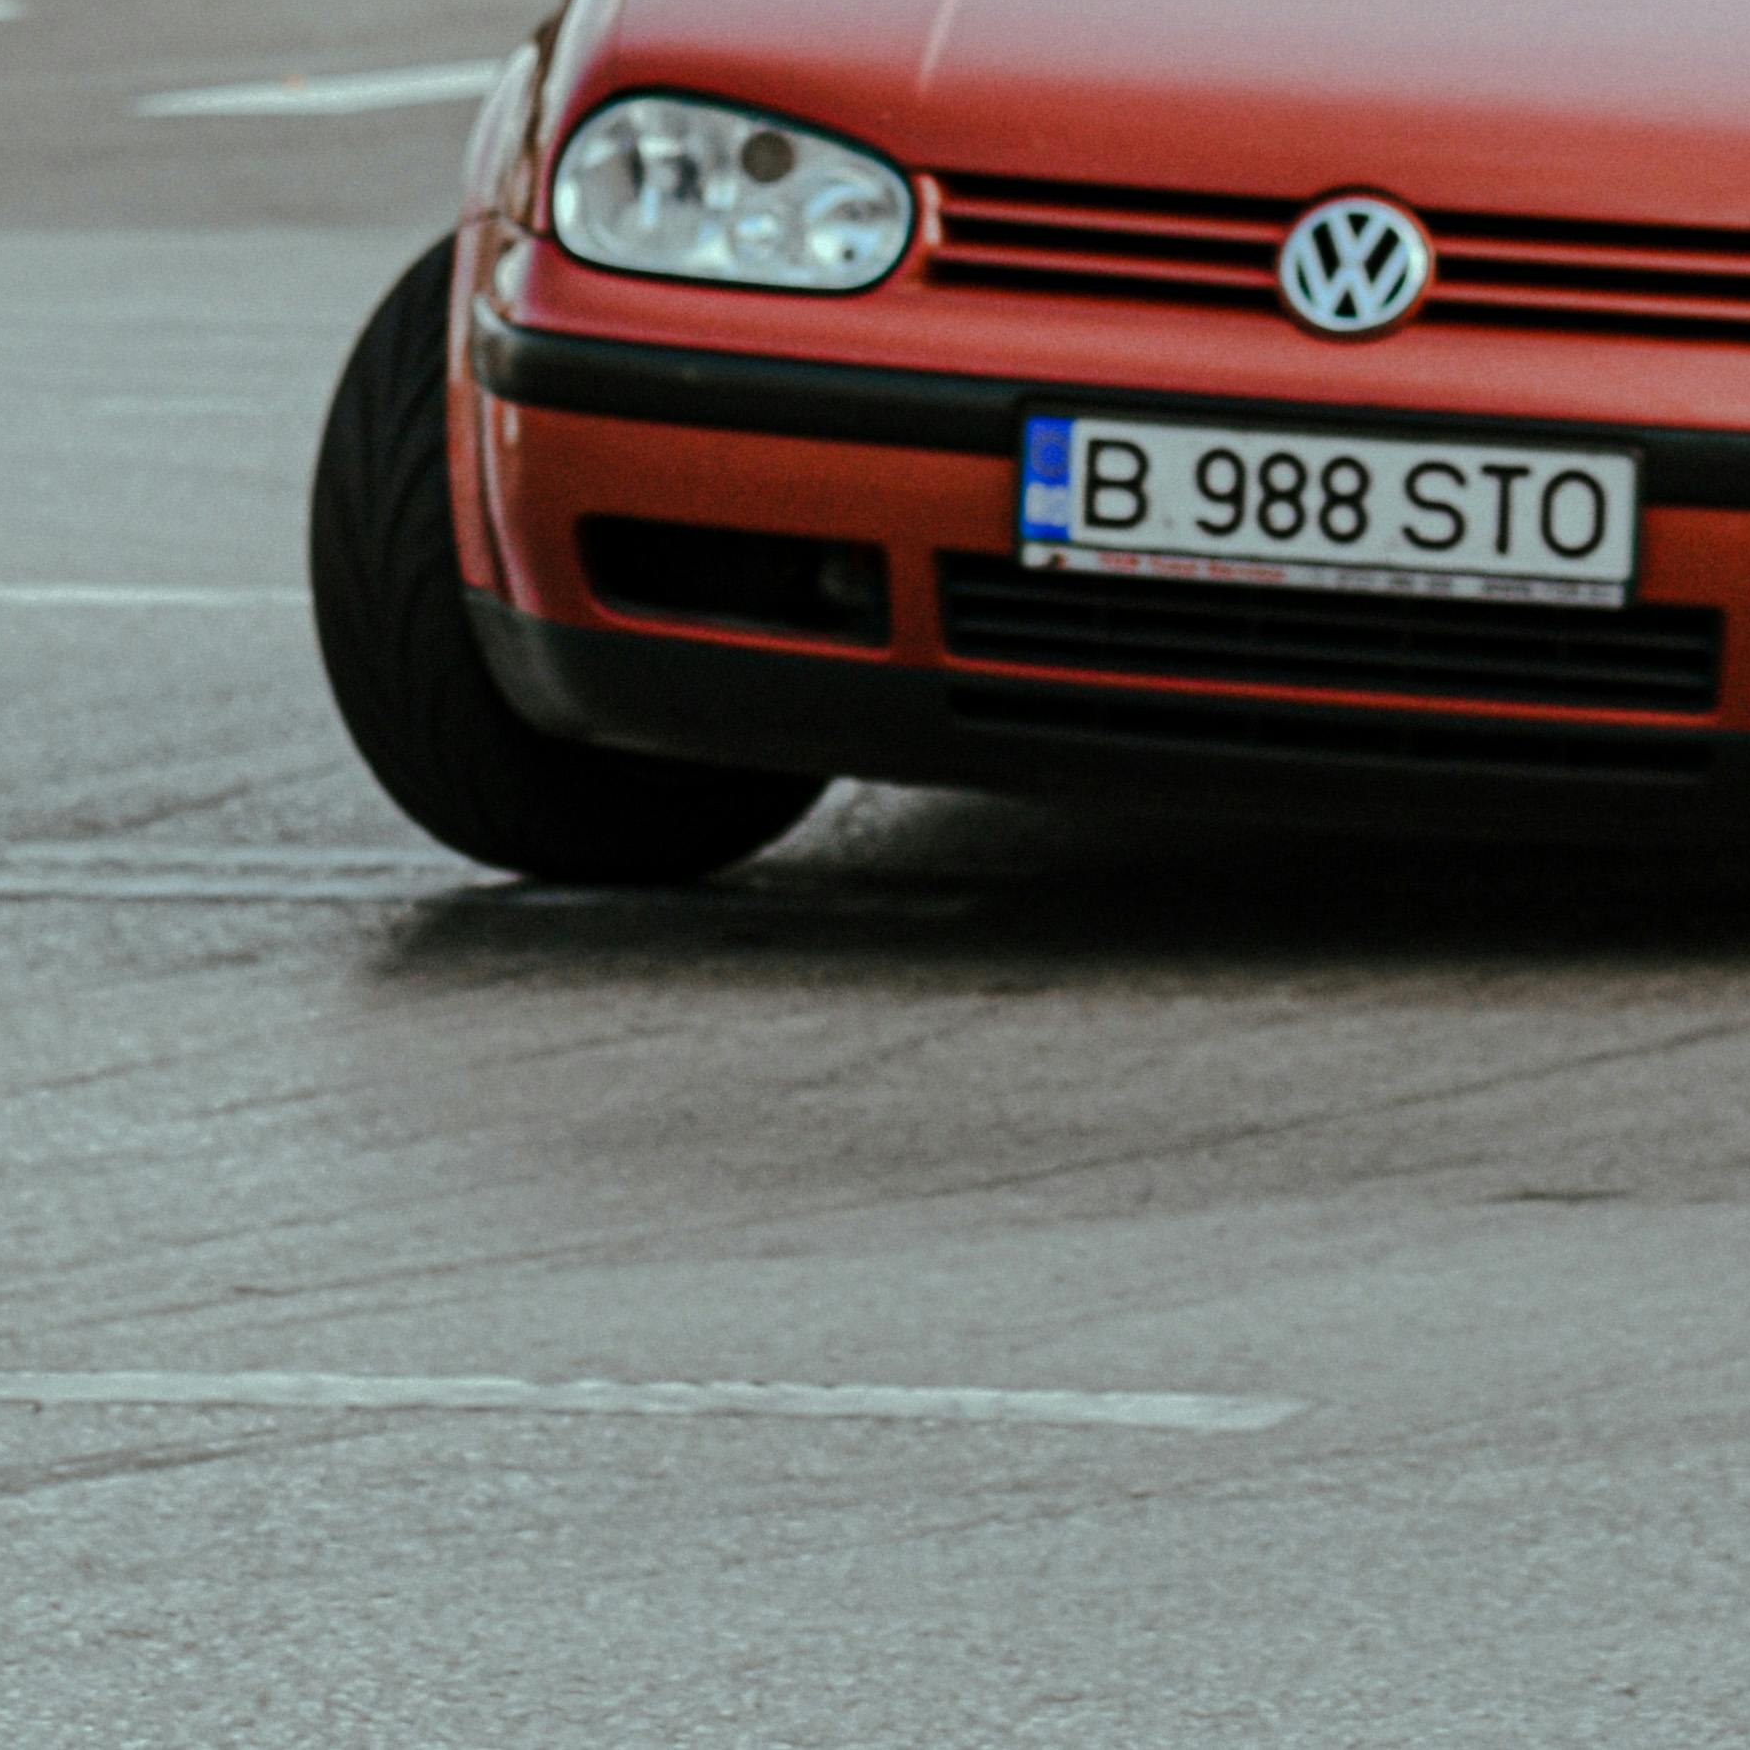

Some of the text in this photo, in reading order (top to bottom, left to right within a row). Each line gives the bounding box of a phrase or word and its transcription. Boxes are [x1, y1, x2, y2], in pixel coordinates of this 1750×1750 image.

[1292, 204, 1416, 327] VW
[1084, 439, 1149, 529] B
[1195, 448, 1370, 544] 988
[1403, 461, 1606, 559] STO
